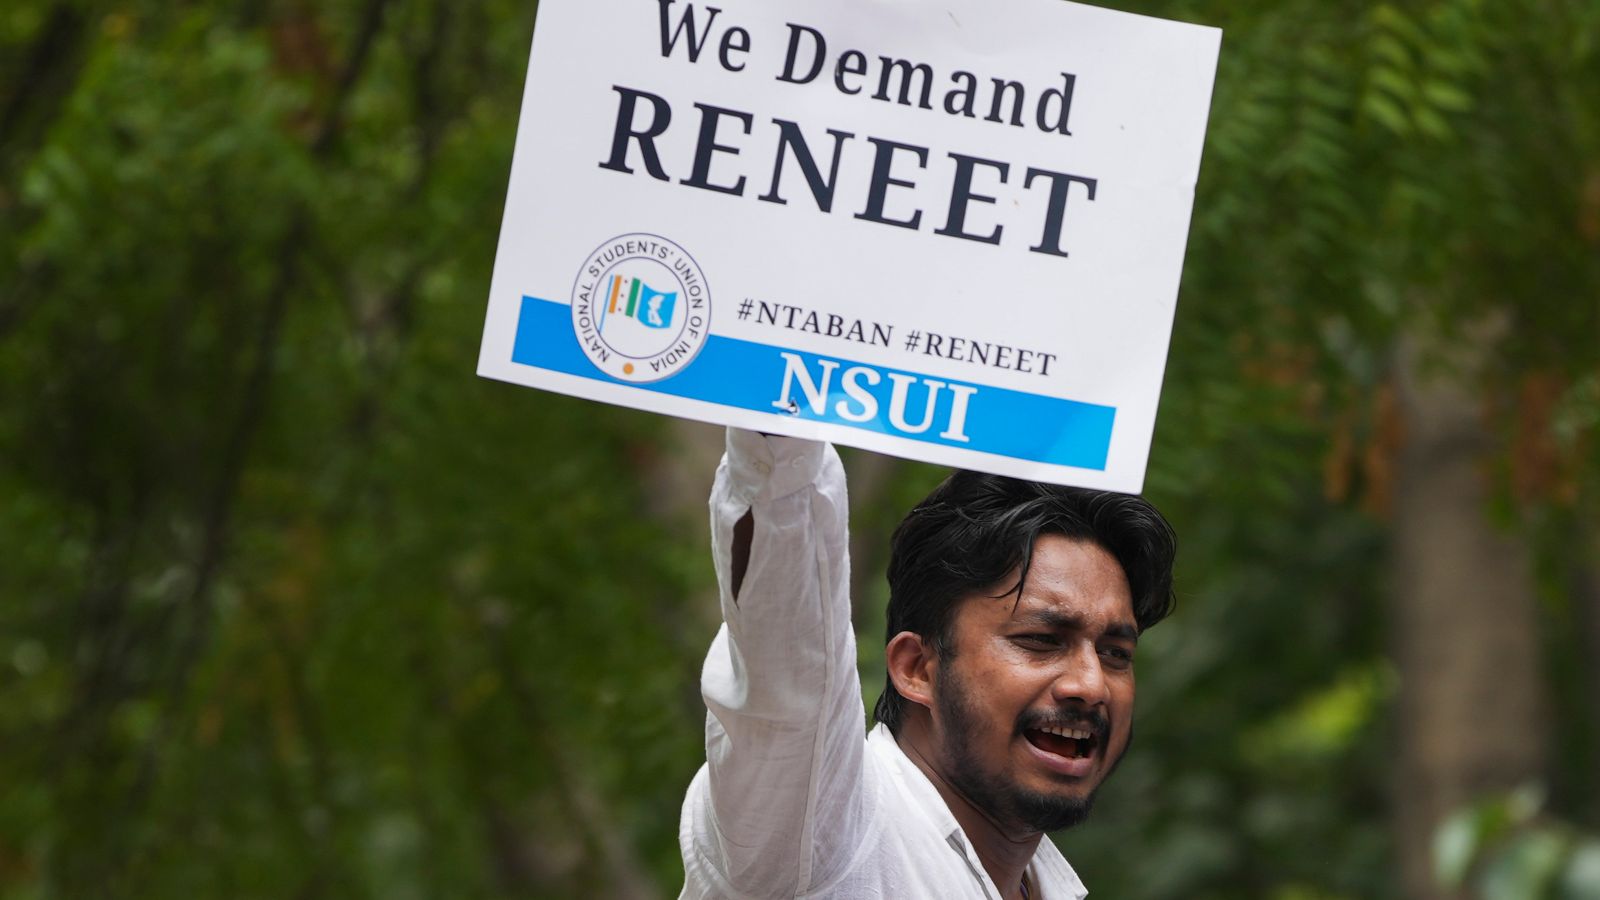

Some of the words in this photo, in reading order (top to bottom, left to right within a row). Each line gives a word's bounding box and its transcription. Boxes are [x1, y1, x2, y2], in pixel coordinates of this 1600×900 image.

[657, 0, 751, 73] We
[775, 22, 1077, 136] Demand
[598, 84, 1098, 258] RENEET
[578, 283, 610, 363] NATIONAL
[674, 258, 703, 309] UNION
[649, 340, 691, 373] INDIA
[688, 315, 702, 340] OF
[737, 297, 894, 347] #NTABAN
[904, 329, 1057, 376] #RENEET
[771, 351, 978, 443] NSUI
